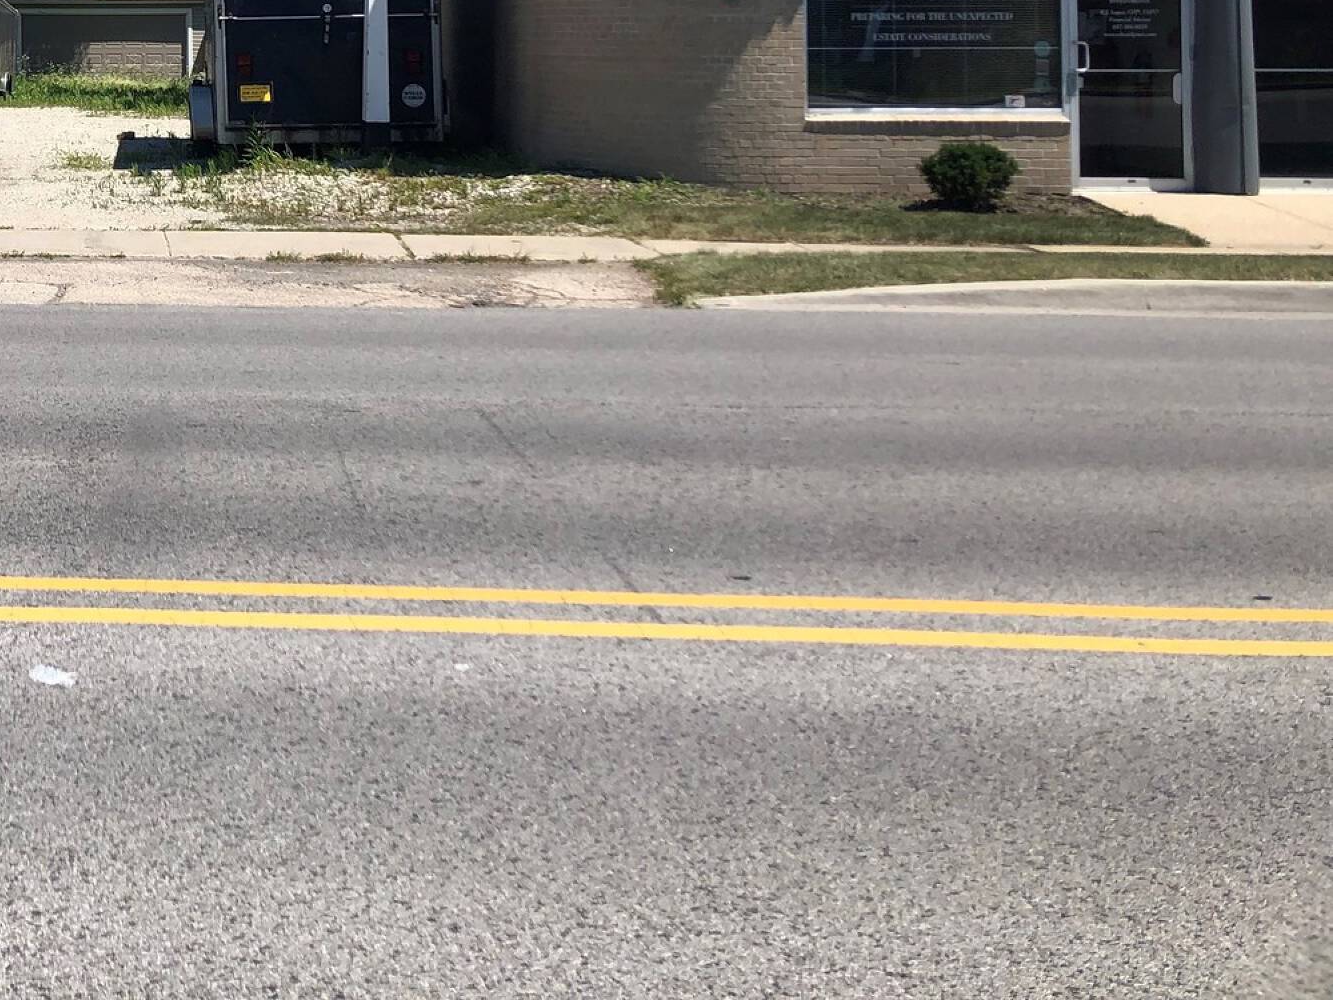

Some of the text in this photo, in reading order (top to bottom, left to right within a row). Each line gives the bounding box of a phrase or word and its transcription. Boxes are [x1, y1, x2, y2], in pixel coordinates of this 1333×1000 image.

[851, 12, 1014, 21] PREPARING FOR THE UNEXPECTED
[873, 32, 992, 41] ESTATE CONSIDERATIONS
